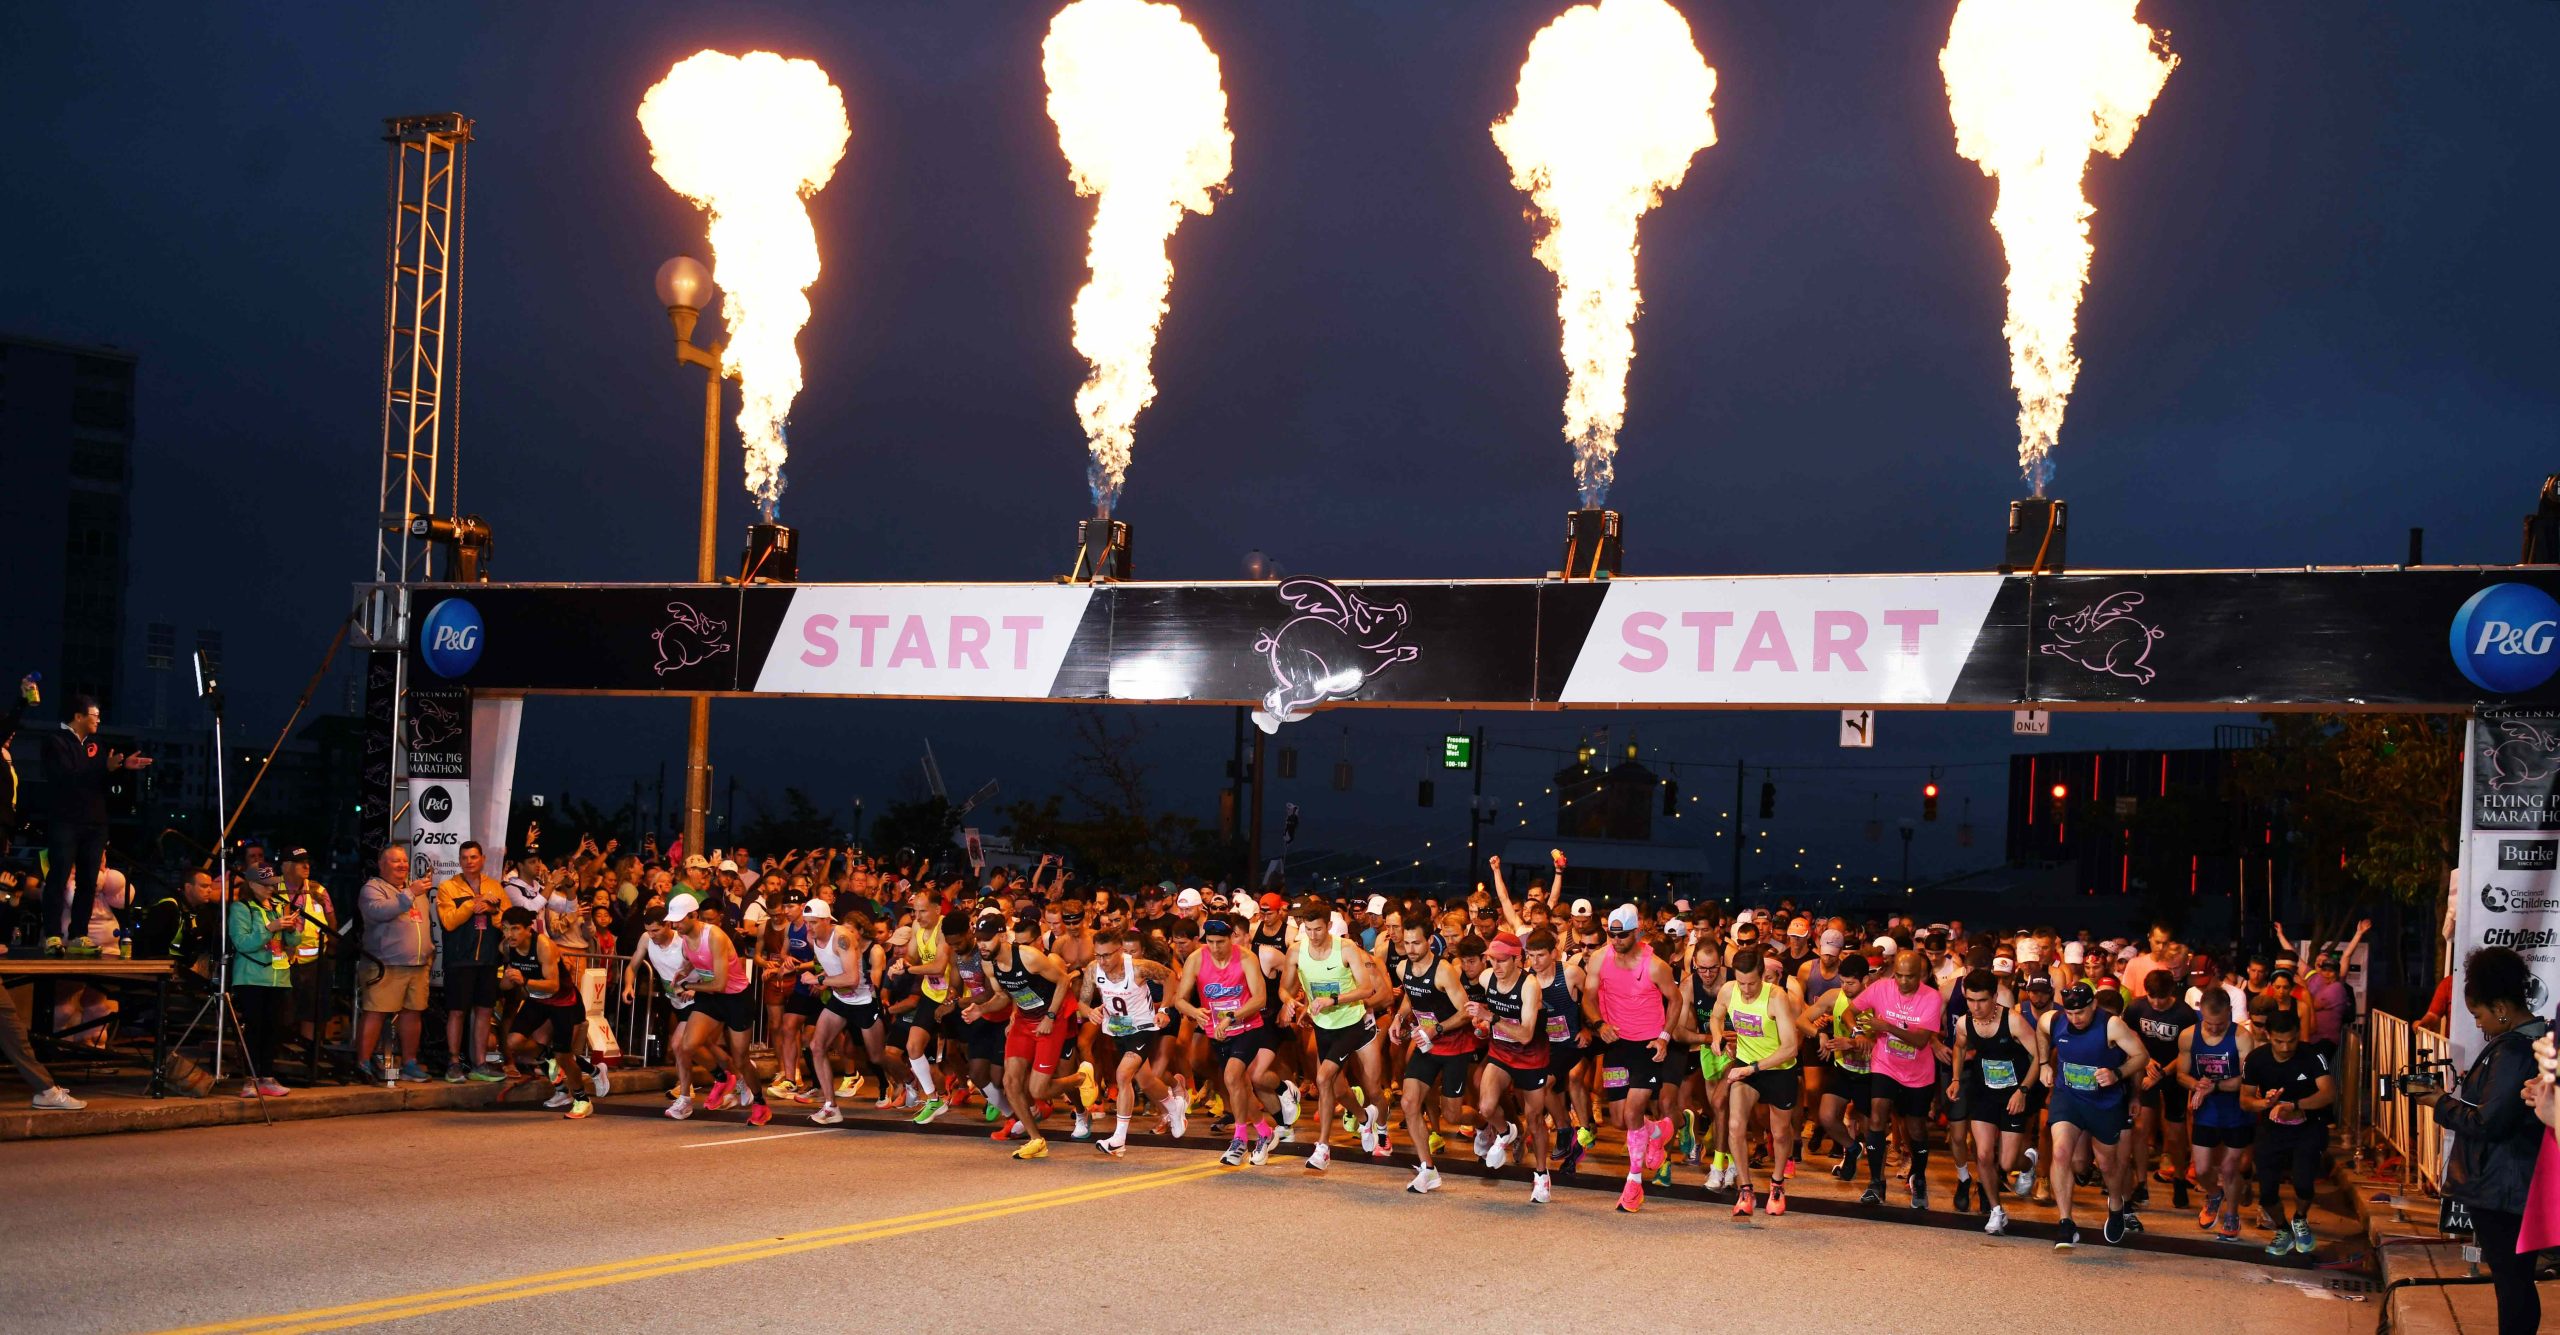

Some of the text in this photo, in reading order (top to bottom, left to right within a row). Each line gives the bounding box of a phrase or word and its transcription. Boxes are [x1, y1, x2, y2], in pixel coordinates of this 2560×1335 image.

[431, 623, 479, 652] P&G
[800, 613, 1045, 671] START
[1618, 608, 1939, 673] START
[2475, 619, 2555, 657] P&G
[2016, 721, 2046, 732] ONLY
[1446, 743, 1458, 751] Way
[409, 752, 463, 763] FLYING PIG
[409, 764, 463, 774] MARATHON
[425, 797, 449, 811] P&G
[2483, 794, 2544, 808] FLYING
[424, 832, 458, 845] asics
[2503, 845, 2554, 861] Burke
[432, 867, 457, 877] County
[2510, 889, 2545, 897] Cincinnati
[2483, 927, 2558, 951] CityDash
[2526, 953, 2556, 964] Solution
[2139, 1017, 2179, 1038] RMU
[2204, 1064, 2224, 1074] 421
